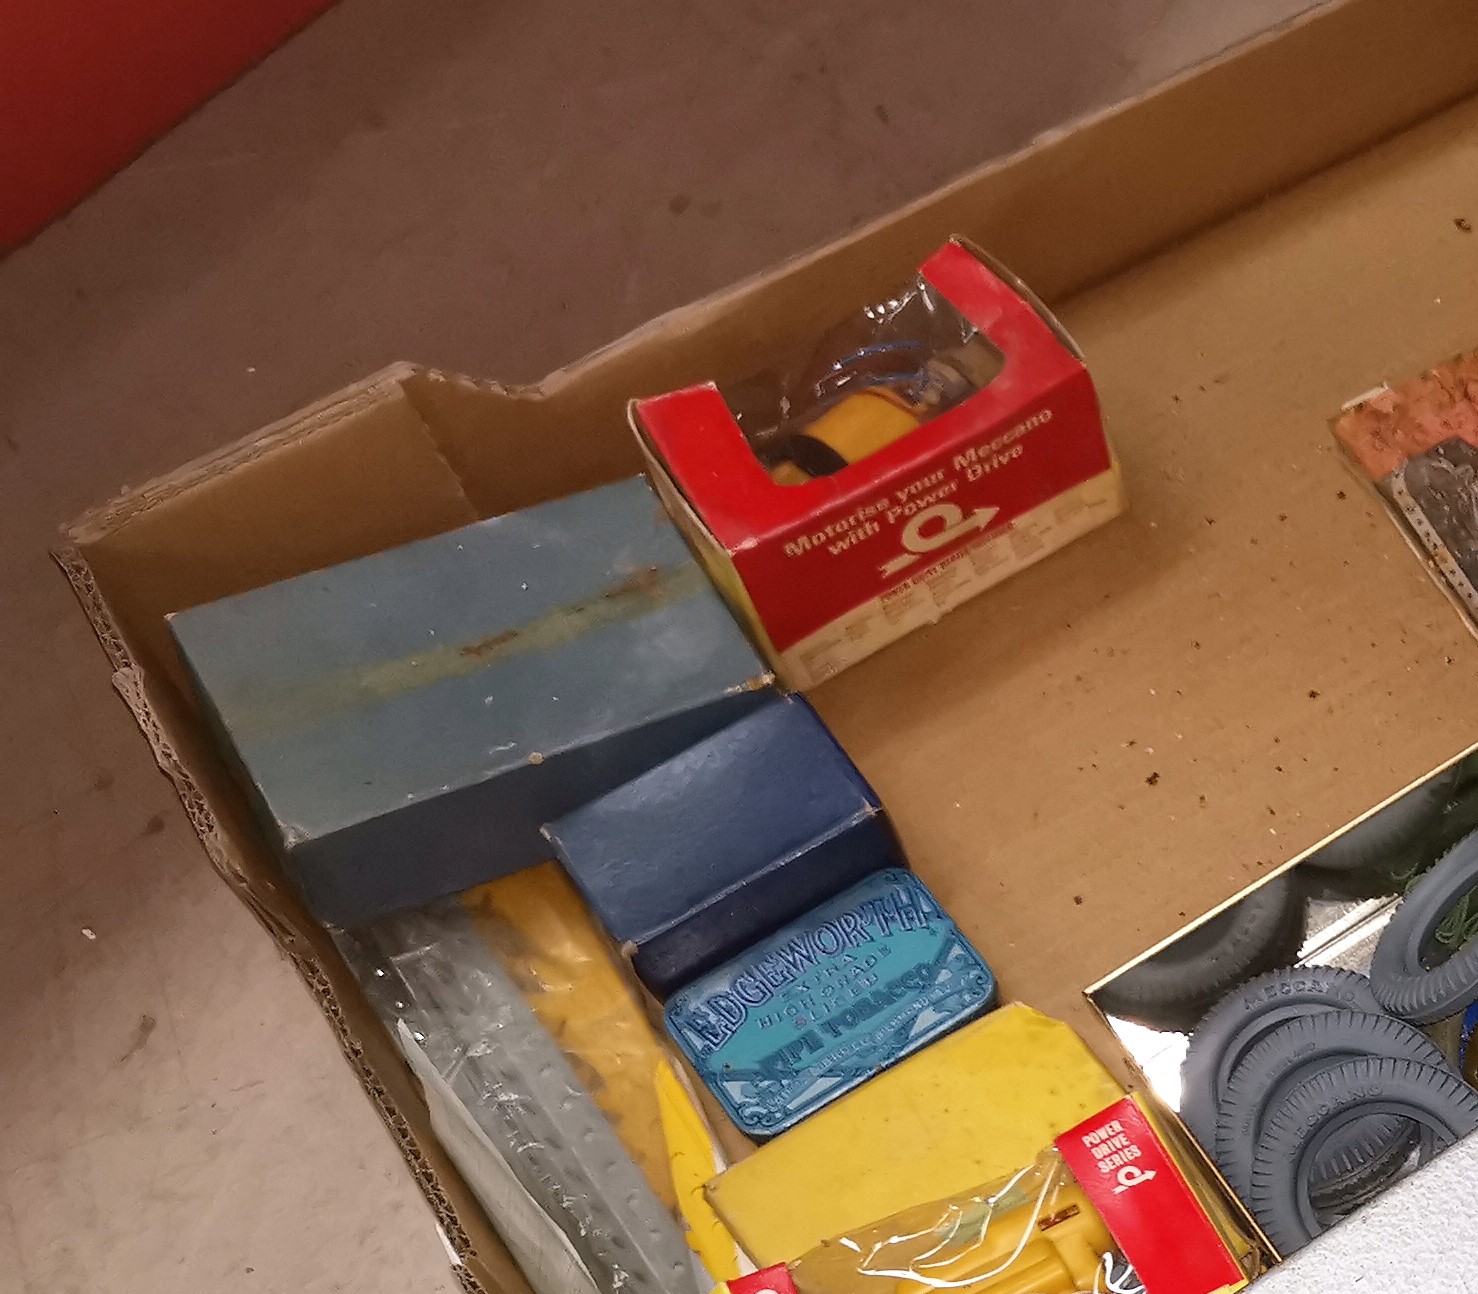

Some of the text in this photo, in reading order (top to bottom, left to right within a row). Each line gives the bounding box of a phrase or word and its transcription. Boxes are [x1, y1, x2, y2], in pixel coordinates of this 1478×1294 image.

[781, 407, 1056, 561] Motorise your Meccano
[825, 442, 1027, 557] with Power Drive
[682, 879, 934, 1052] EDGEWORTH
[1081, 1119, 1124, 1147] POWER
[1091, 1132, 1131, 1160] DRIVE
[1097, 1144, 1142, 1173] SERIES
